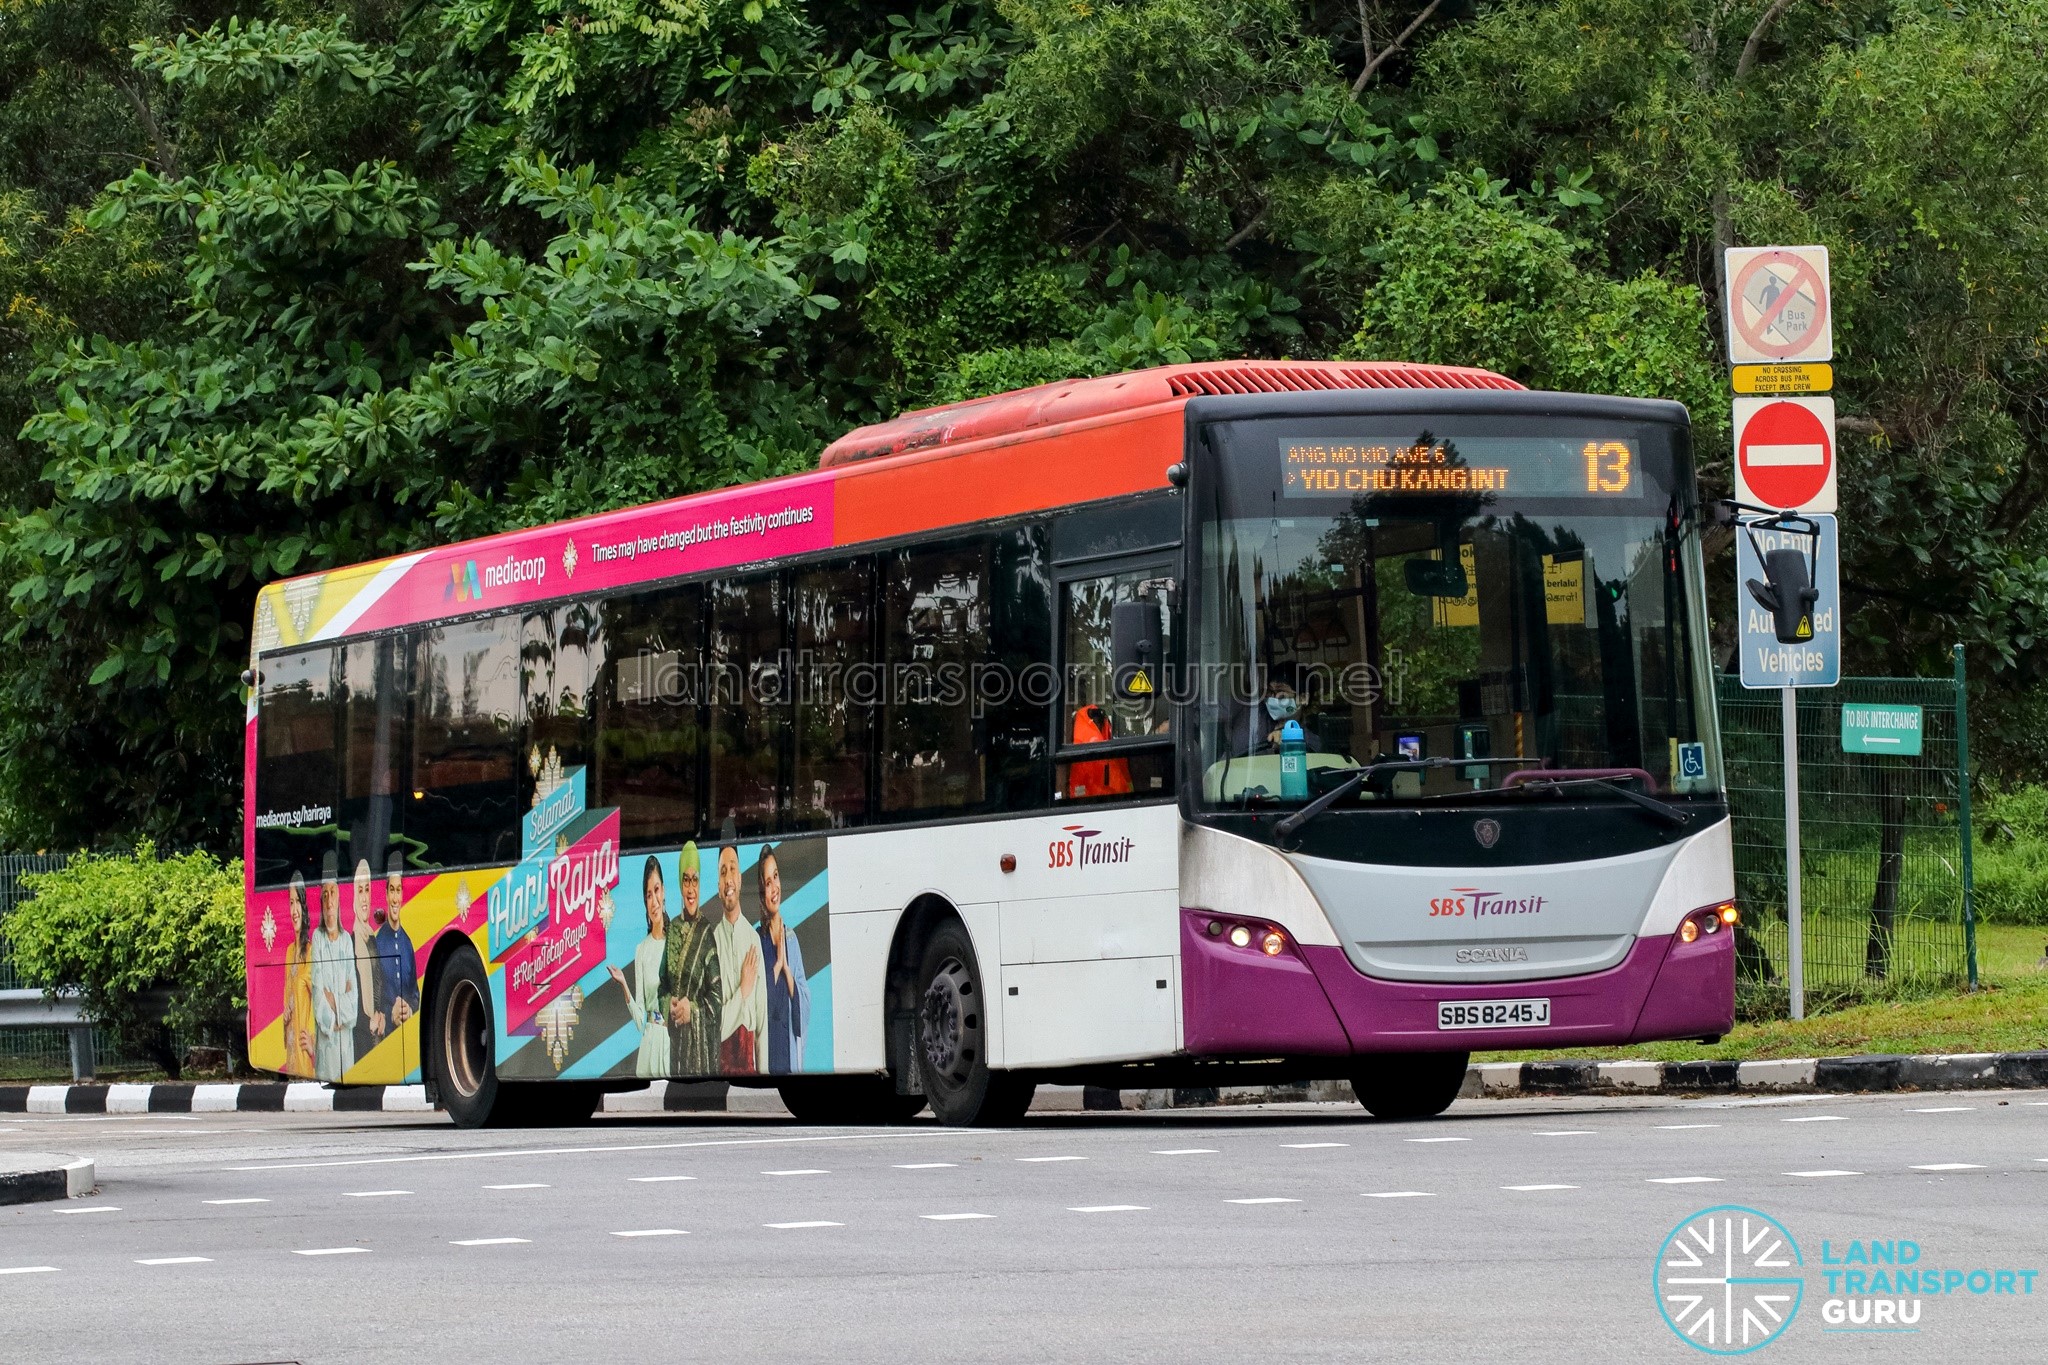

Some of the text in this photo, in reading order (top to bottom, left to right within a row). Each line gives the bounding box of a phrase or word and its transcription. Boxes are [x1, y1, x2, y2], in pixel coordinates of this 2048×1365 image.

[1786, 321, 1808, 332] Park
[1787, 310, 1806, 320] Bus
[1755, 375, 1778, 383] ACROSS
[1794, 374, 1811, 382] PARK
[1773, 366, 1802, 374] CROSSING
[1754, 384, 1776, 392] EXCEPT
[1793, 383, 1811, 391] CREW
[1288, 446, 1446, 463] ANG MO KIO AVE 6
[1583, 441, 1631, 492] 13
[1301, 469, 1509, 490] YIO CHU KANG INT
[591, 506, 813, 563] Times may have changed but the festivity continues
[1754, 530, 1776, 555] No
[485, 555, 546, 588] mediacorp
[1758, 647, 1824, 673] Vehicles
[1846, 710, 1919, 730] TO BUS INTERCHANGE
[256, 803, 332, 828] mediacorp.sg/hariraya
[529, 778, 576, 841] Selamat
[1048, 830, 1136, 871] SBS Transit
[489, 838, 617, 949] Hari Raya
[1429, 892, 1549, 920] SBS Transit
[512, 922, 588, 992] #RayaTetapRaya
[1455, 946, 1529, 964] SCANIA
